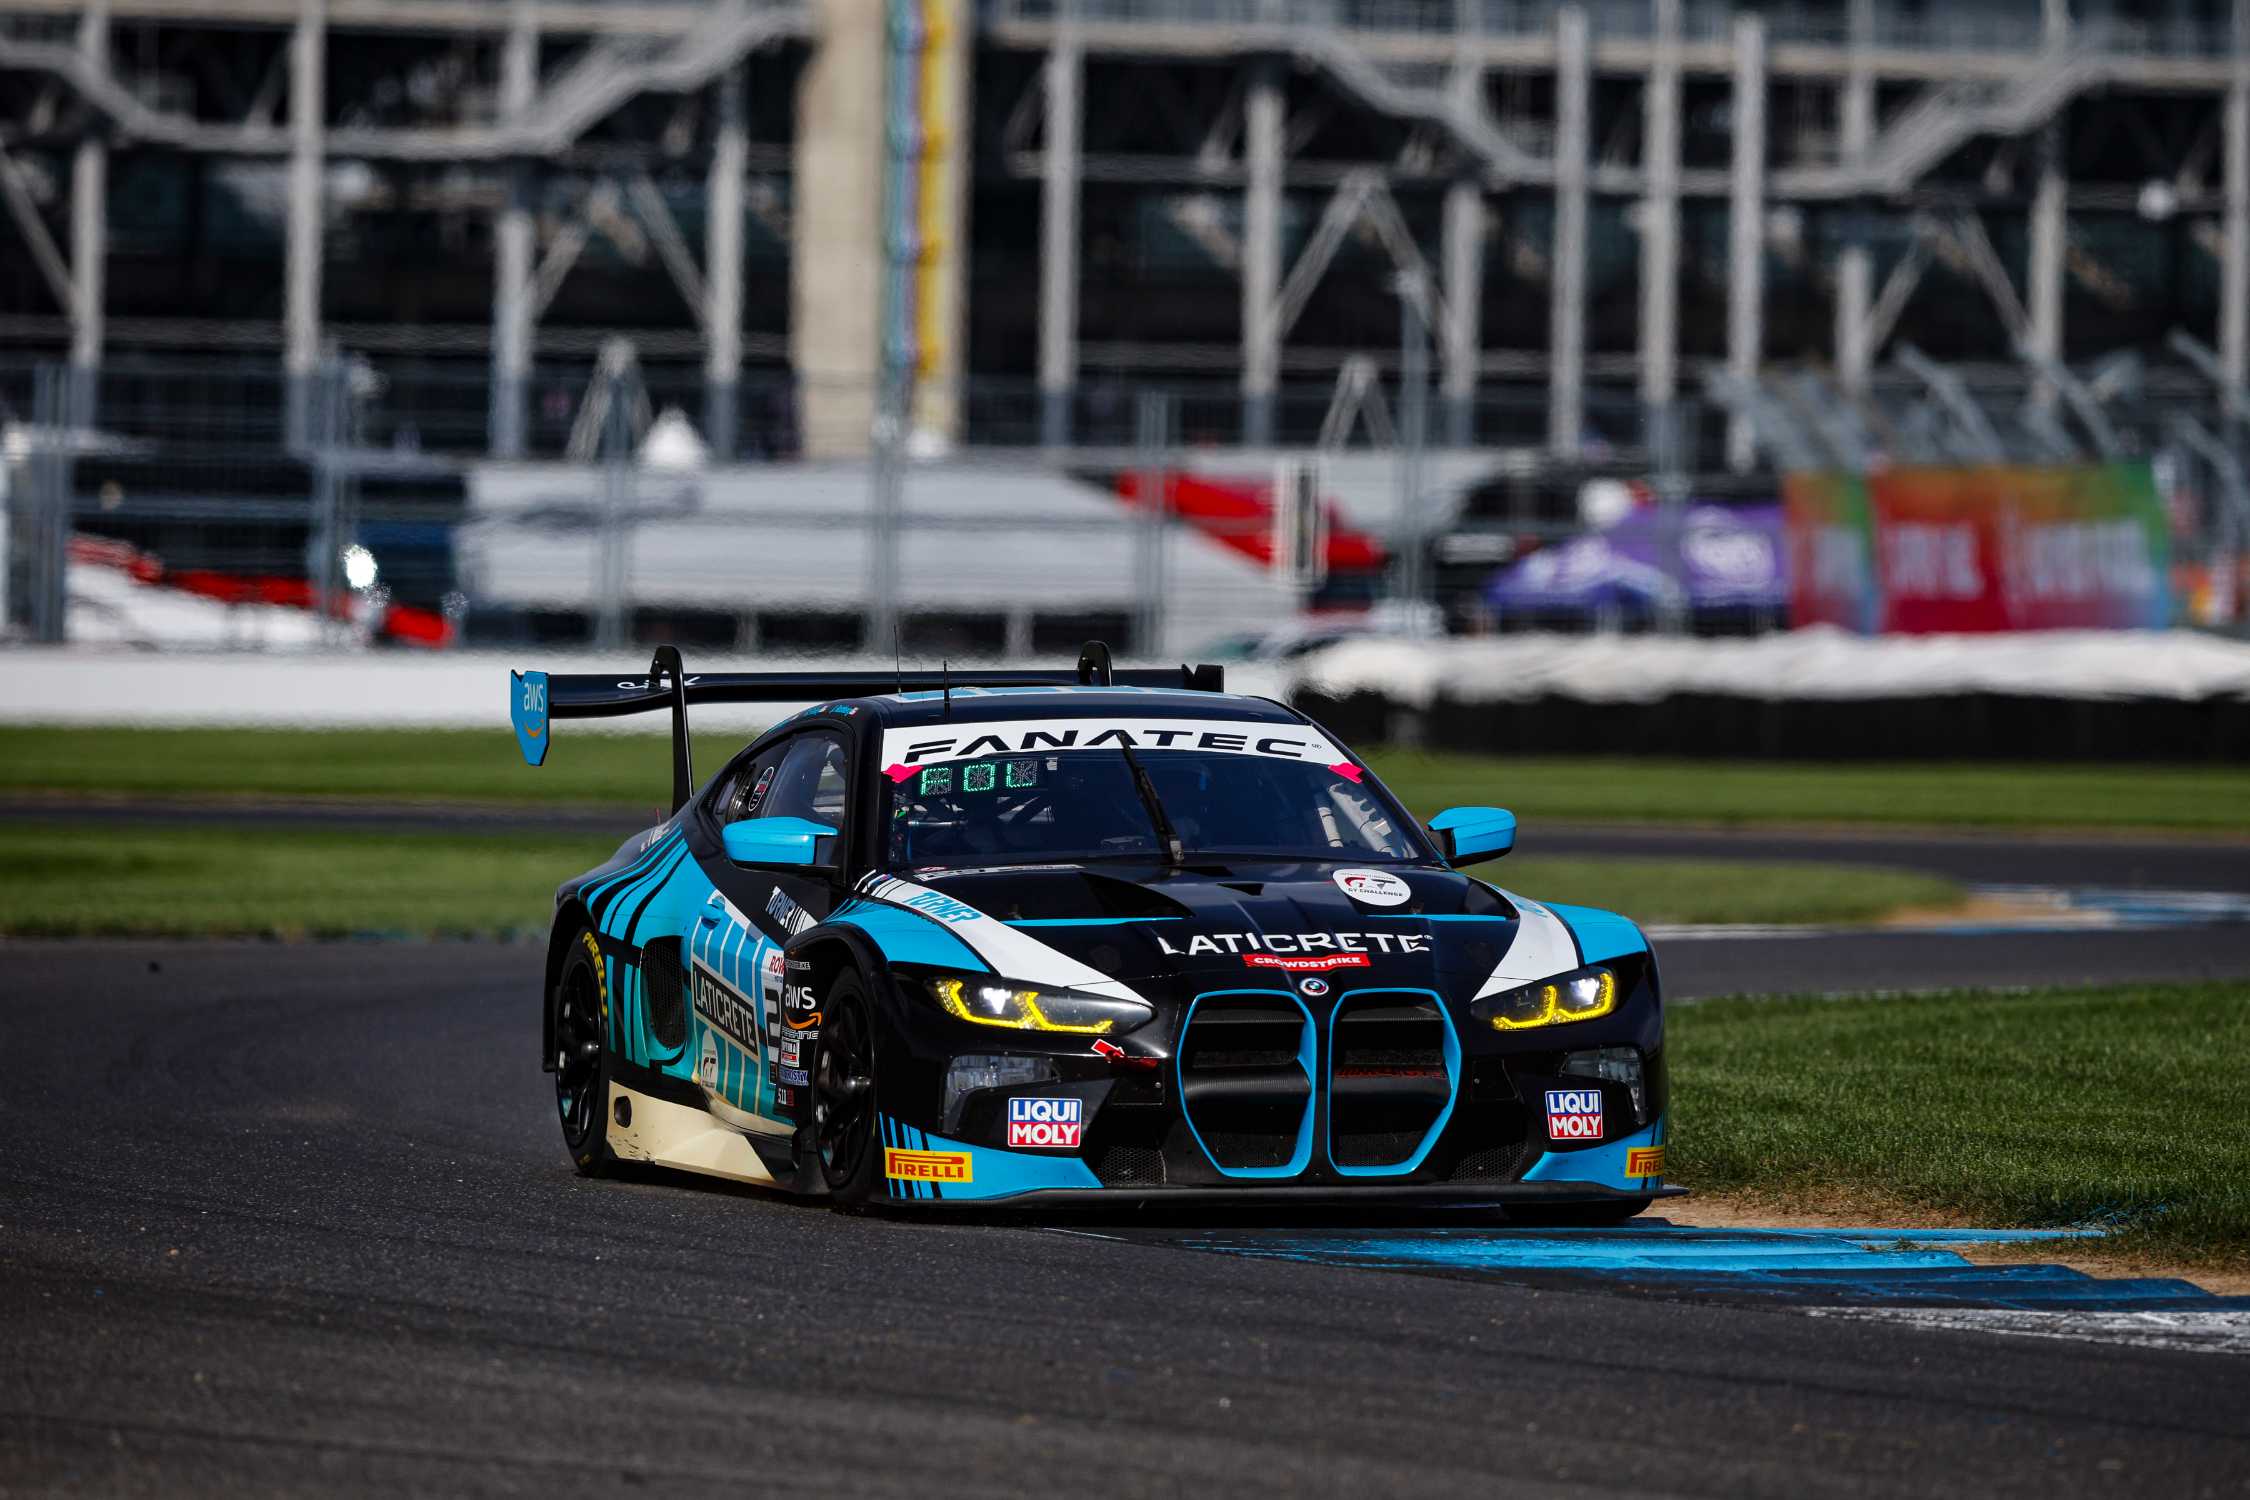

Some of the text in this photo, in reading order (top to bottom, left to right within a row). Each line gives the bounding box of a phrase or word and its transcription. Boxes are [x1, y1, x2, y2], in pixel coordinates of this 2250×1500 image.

[524, 682, 544, 712] aws
[904, 729, 1307, 763] FANATEC
[902, 891, 983, 923] TURNER
[1157, 932, 1430, 955] LATICRETE
[1253, 956, 1362, 969] CROWDSTRIKE
[785, 983, 816, 1010] aws
[694, 975, 757, 1049] LATICRETE
[1012, 1100, 1078, 1122] LIQUI
[1548, 1092, 1600, 1114] LIQUI
[1012, 1124, 1079, 1145] MOLY
[1551, 1115, 1601, 1137] MOLY
[888, 1152, 965, 1179] PIRELLI
